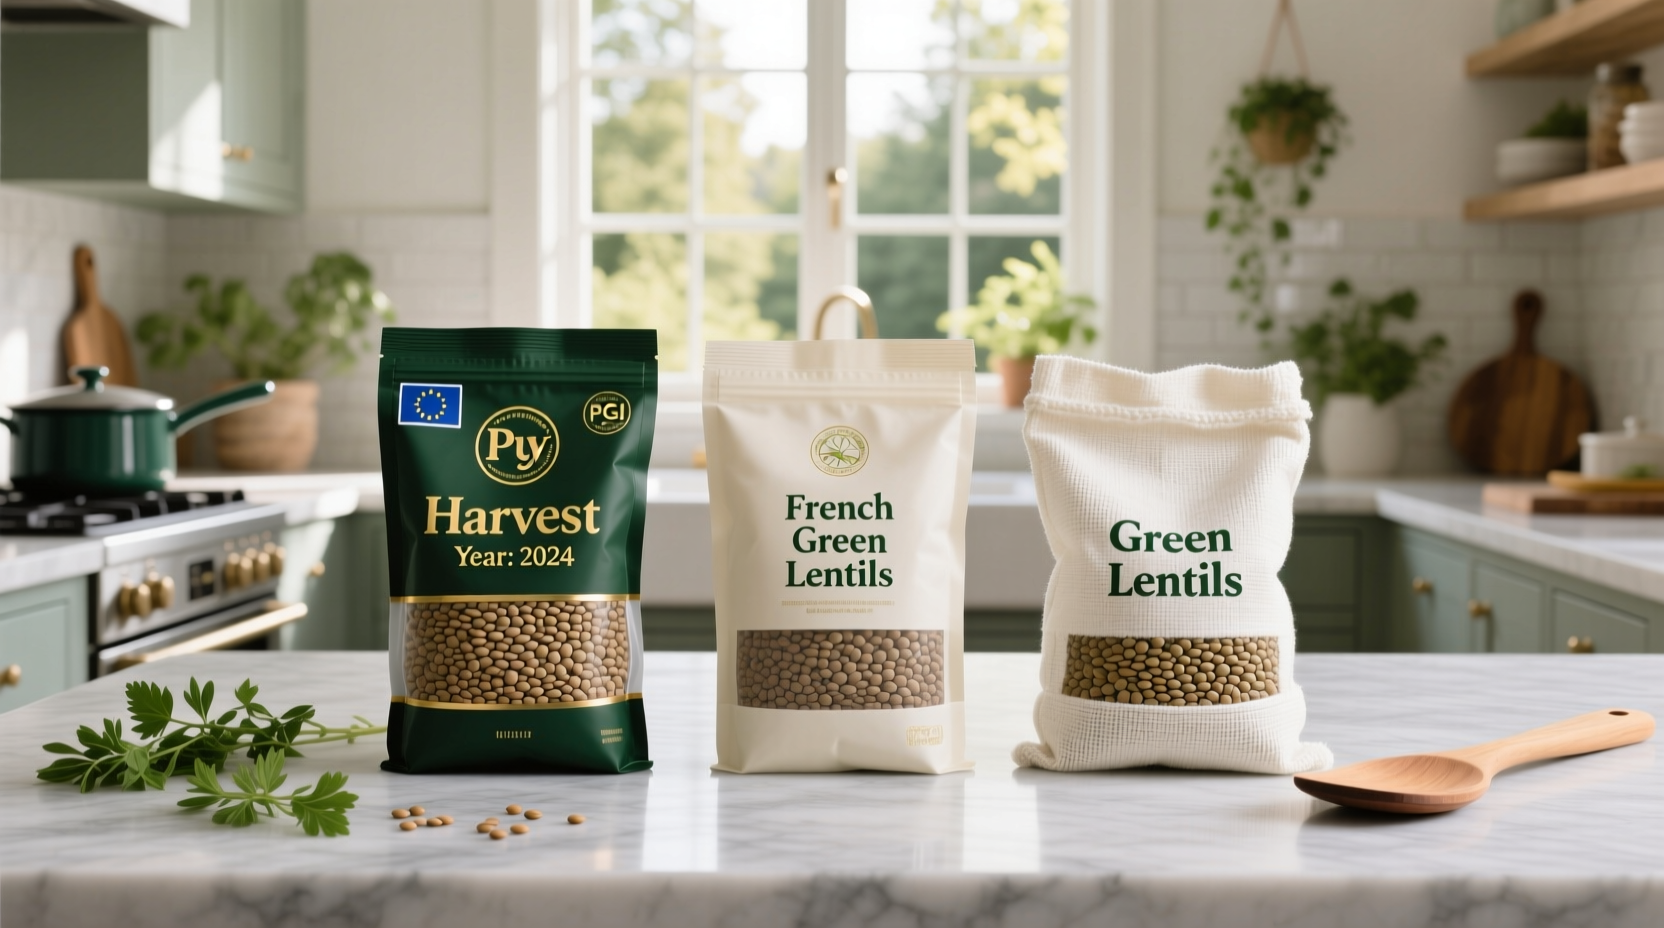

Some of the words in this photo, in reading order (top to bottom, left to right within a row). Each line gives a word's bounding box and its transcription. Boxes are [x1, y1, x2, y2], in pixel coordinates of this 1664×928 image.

[590, 402, 625, 422] PGI
[424, 495, 601, 535] Harvest
[785, 492, 894, 520] French
[792, 526, 887, 554] Green
[1109, 519, 1233, 553] Green
[454, 545, 514, 567] Year:
[519, 545, 575, 567] 2024
[785, 559, 893, 588] Lentils
[1108, 560, 1243, 598] Lentils
